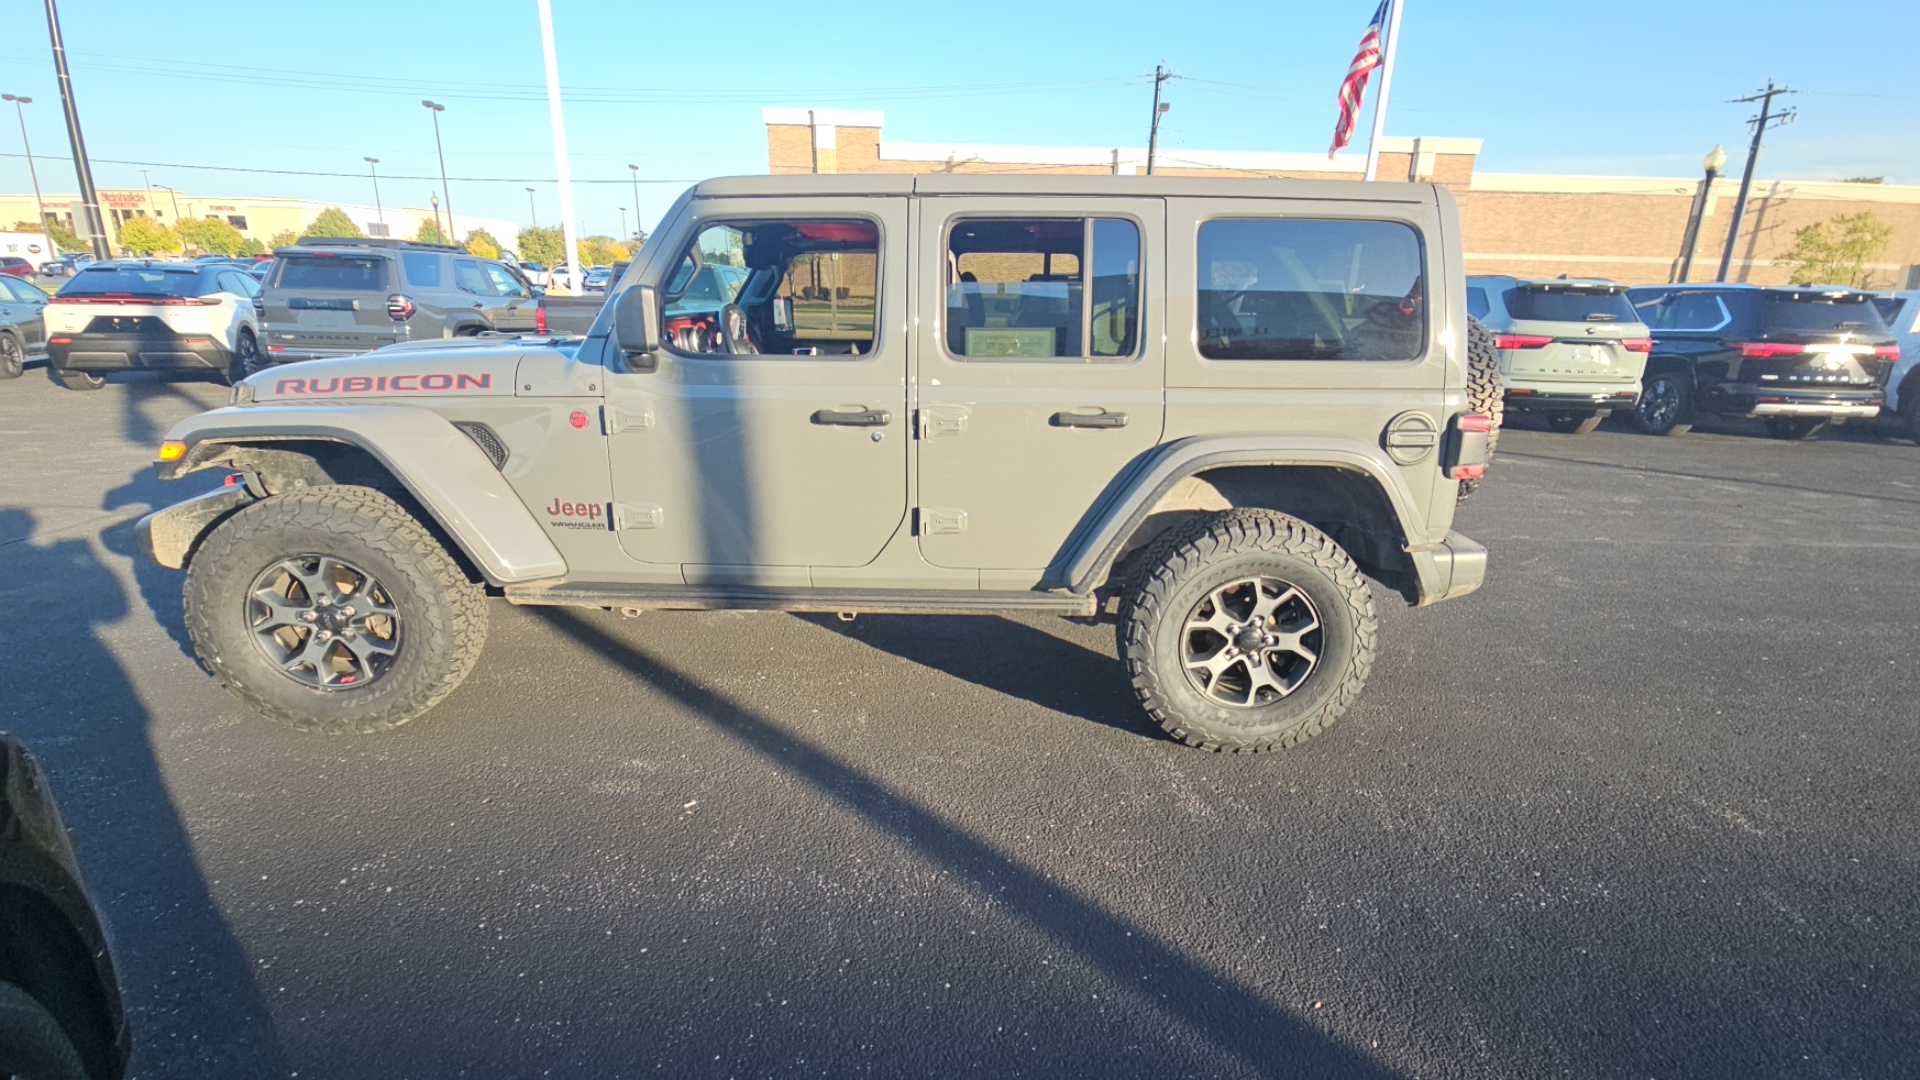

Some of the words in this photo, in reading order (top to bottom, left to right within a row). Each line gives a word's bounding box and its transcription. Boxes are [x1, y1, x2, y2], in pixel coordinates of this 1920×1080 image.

[274, 373, 493, 396] RUBICON
[546, 497, 604, 520] Jeep
[550, 521, 606, 529] WRANGLER
